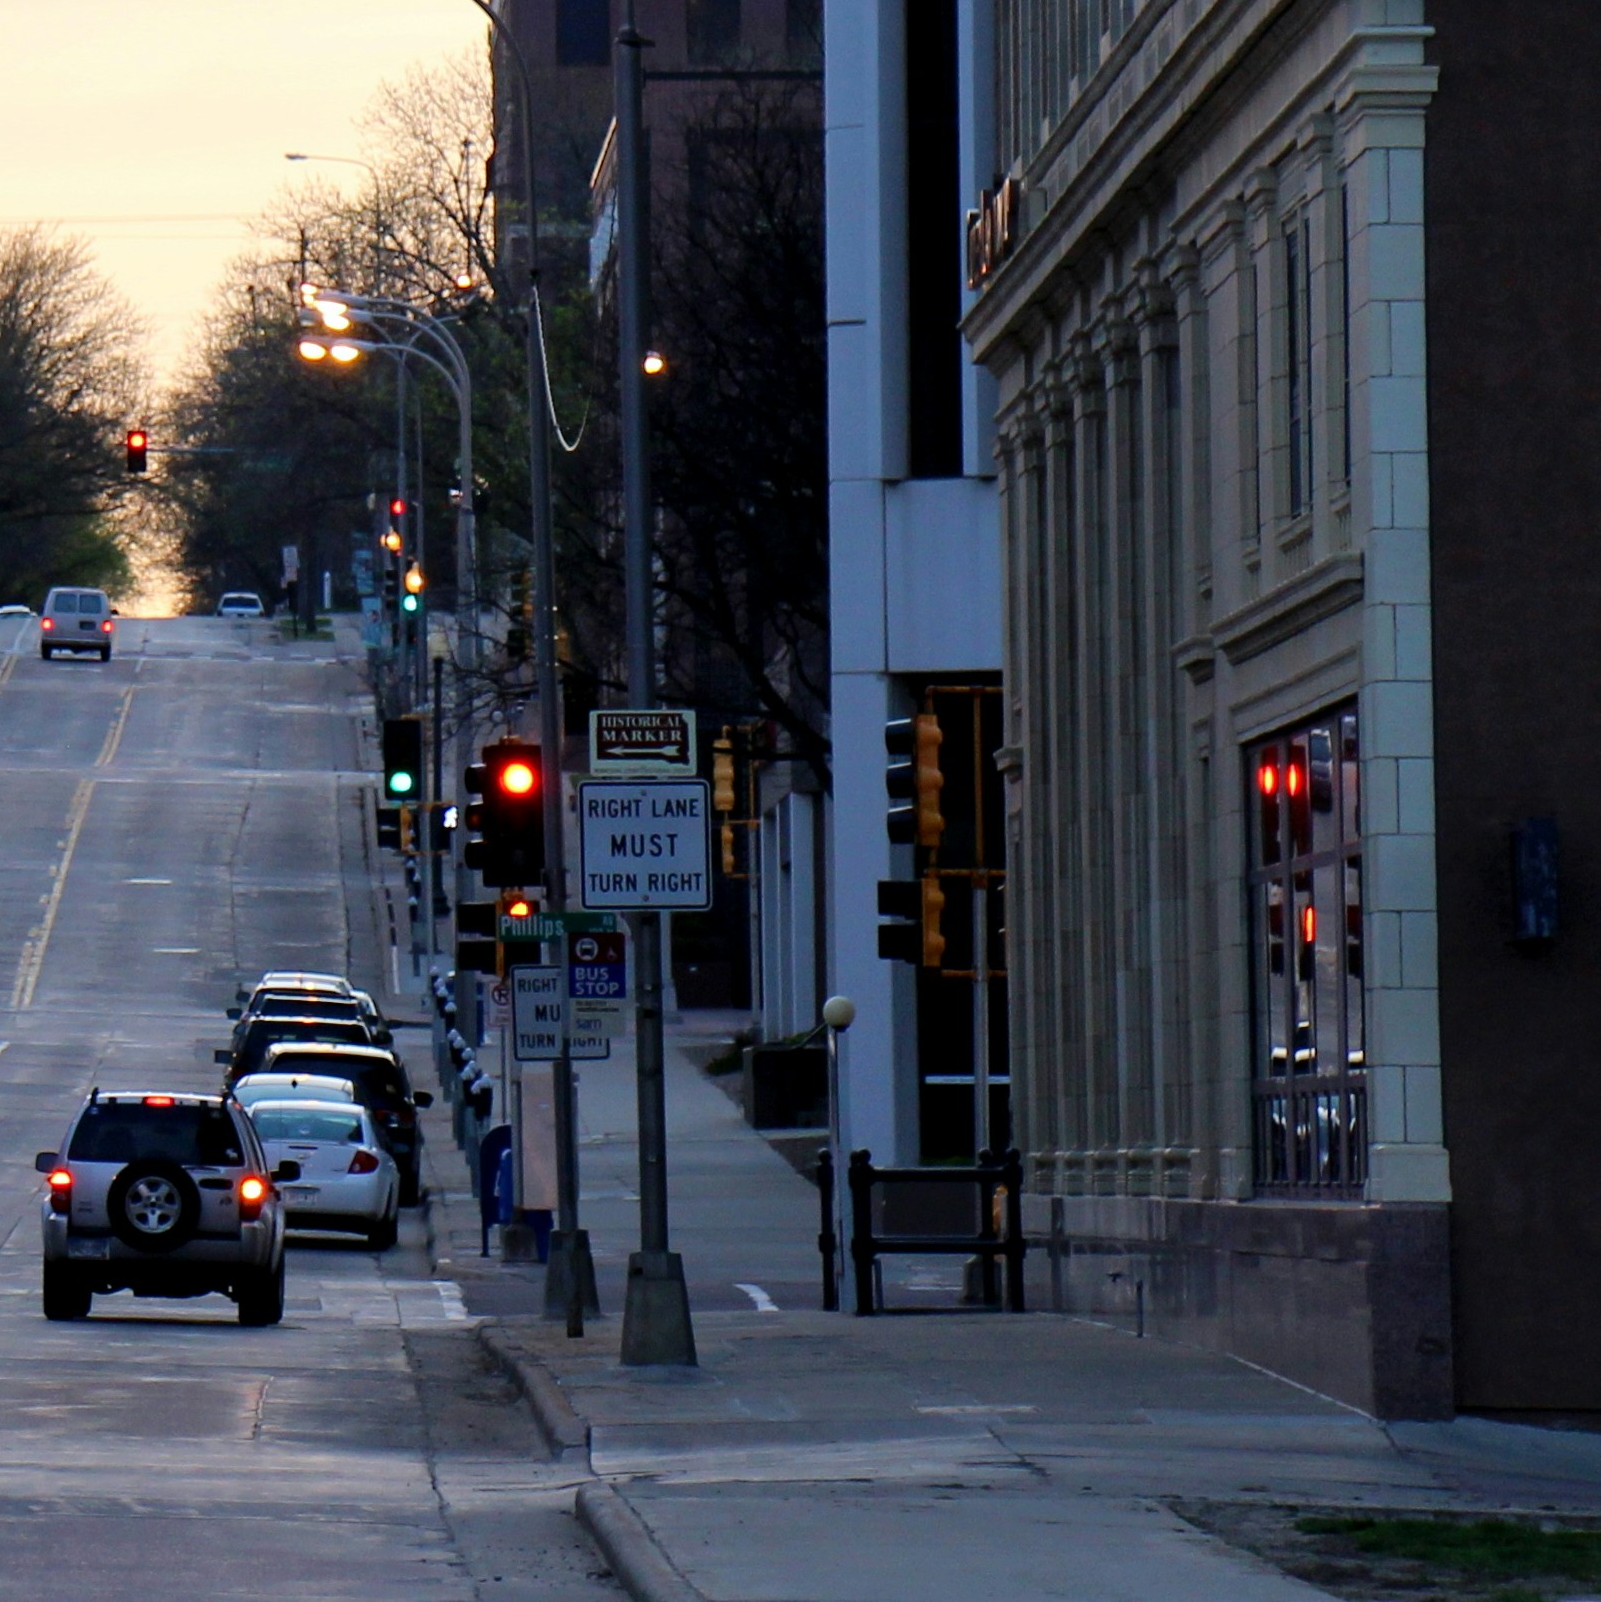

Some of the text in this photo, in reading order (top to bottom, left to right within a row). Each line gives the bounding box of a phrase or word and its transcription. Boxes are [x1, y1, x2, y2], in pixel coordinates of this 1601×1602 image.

[601, 715, 682, 728] HISTORICAL
[602, 729, 683, 743] MARKER
[588, 798, 700, 818] RIGHT LANE
[611, 834, 679, 857] MUST
[589, 873, 702, 893] TURN RIGHT
[501, 915, 565, 939] Phillips
[575, 966, 609, 981] BUS
[517, 978, 557, 993] RIGHT
[575, 982, 620, 996] STOP
[535, 1005, 561, 1022] MU
[519, 1034, 604, 1048] TURN IGHT
